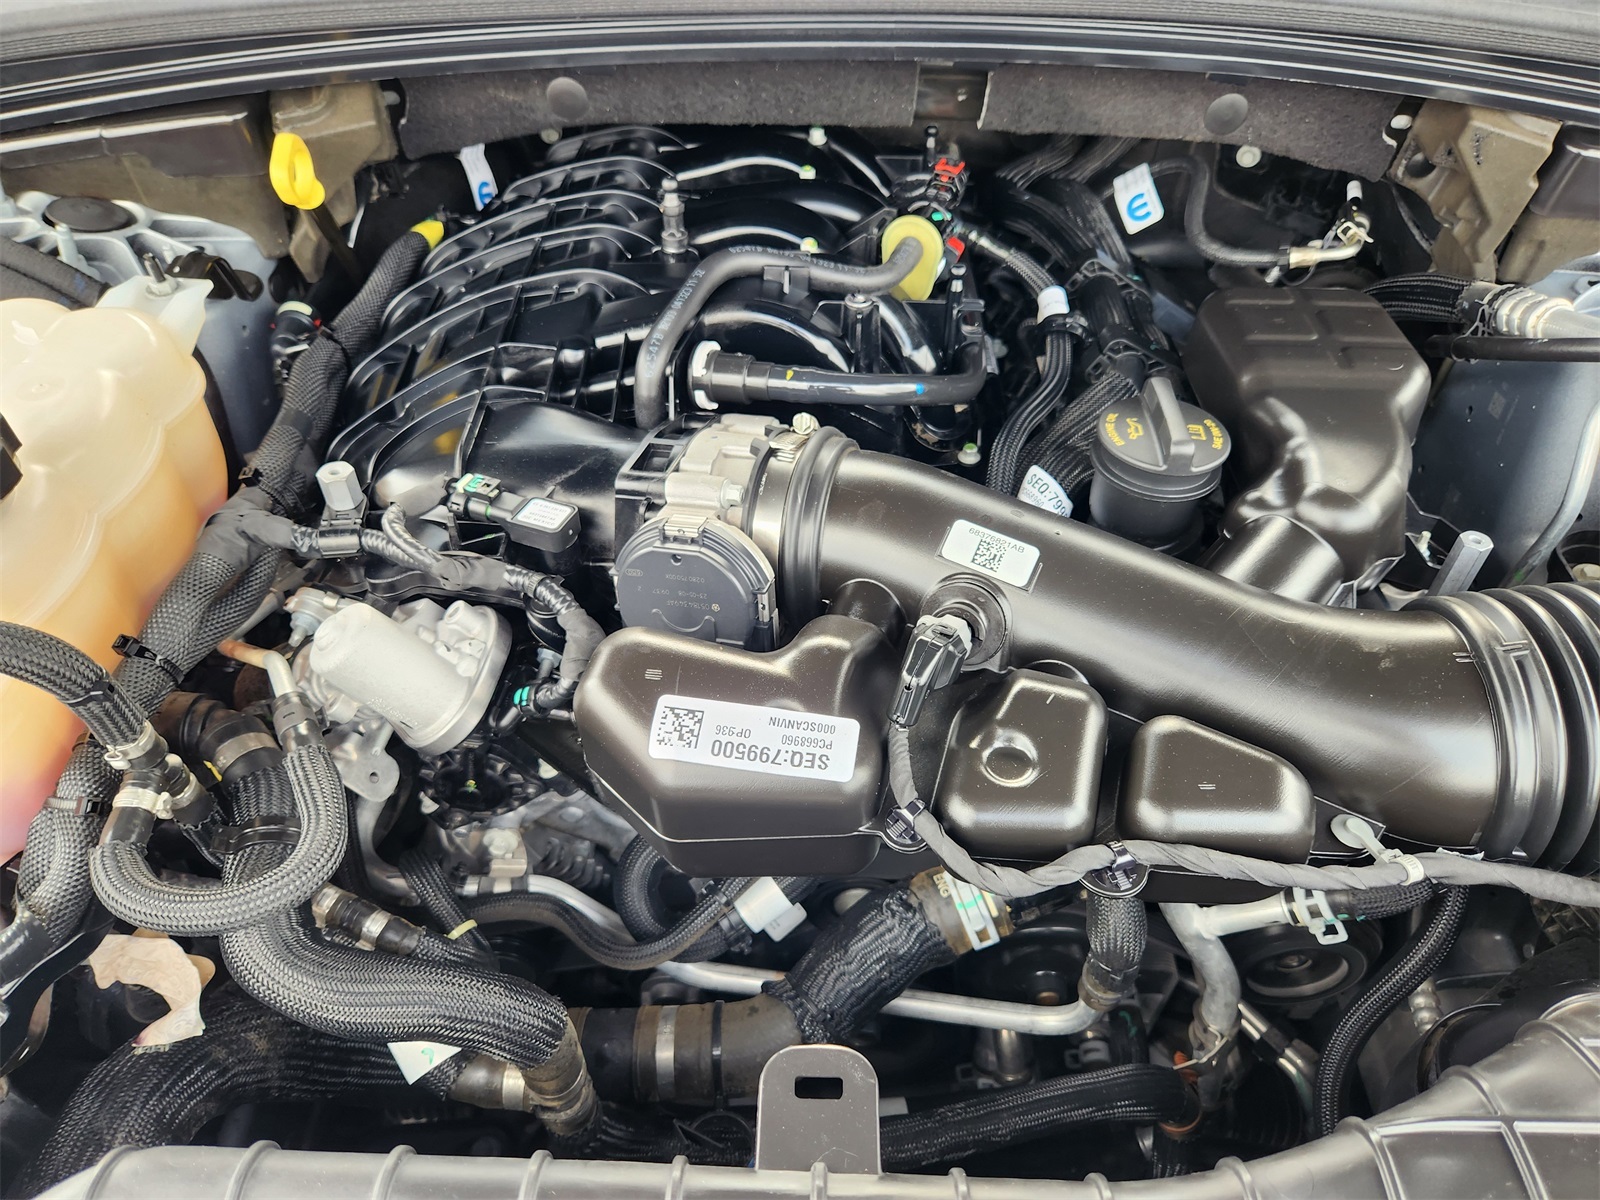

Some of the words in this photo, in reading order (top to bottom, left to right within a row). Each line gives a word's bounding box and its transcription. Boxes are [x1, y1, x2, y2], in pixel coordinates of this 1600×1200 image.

[1105, 422, 1125, 446] ENGINE
[968, 527, 1025, 554] 68376821AB
[768, 716, 836, 735] 000SCANVIN
[781, 733, 833, 750] PC668960
[710, 739, 831, 771] SEQ:799500
[933, 873, 951, 898] ENG
